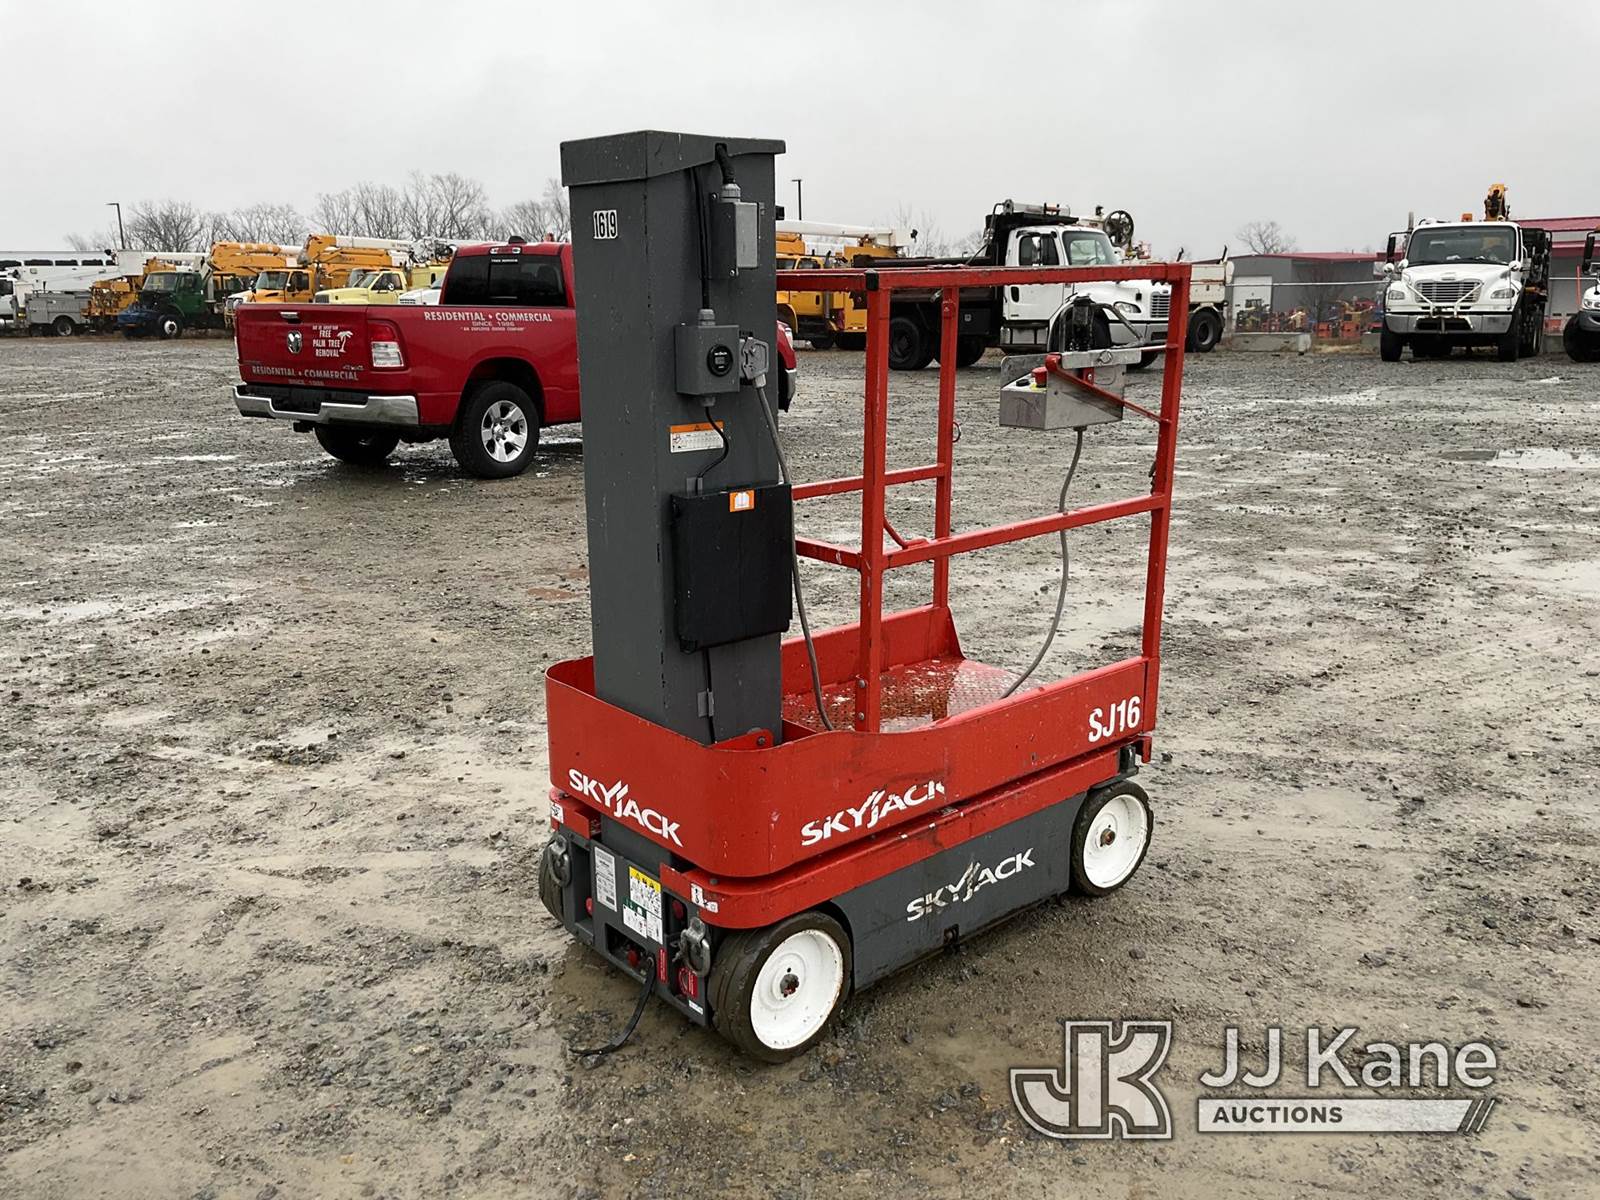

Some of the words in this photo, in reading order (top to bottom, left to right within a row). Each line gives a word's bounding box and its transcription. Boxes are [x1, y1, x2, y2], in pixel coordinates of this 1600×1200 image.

[594, 211, 617, 238] 1619
[424, 311, 485, 321] RESIDENTIAL
[495, 312, 552, 322] COMMERCIAL
[312, 339, 326, 348] PALM
[328, 339, 341, 348] TREE
[319, 330, 331, 338] FREE
[315, 349, 340, 358] REMOVAL
[252, 366, 296, 377] RESIDENTIAL
[304, 369, 359, 381] COMMERCIAL
[1088, 695, 1141, 742] SJ16
[568, 768, 683, 848] SKYJACK
[800, 780, 945, 846] SKYJACK
[906, 847, 1036, 922] SKYJACK
